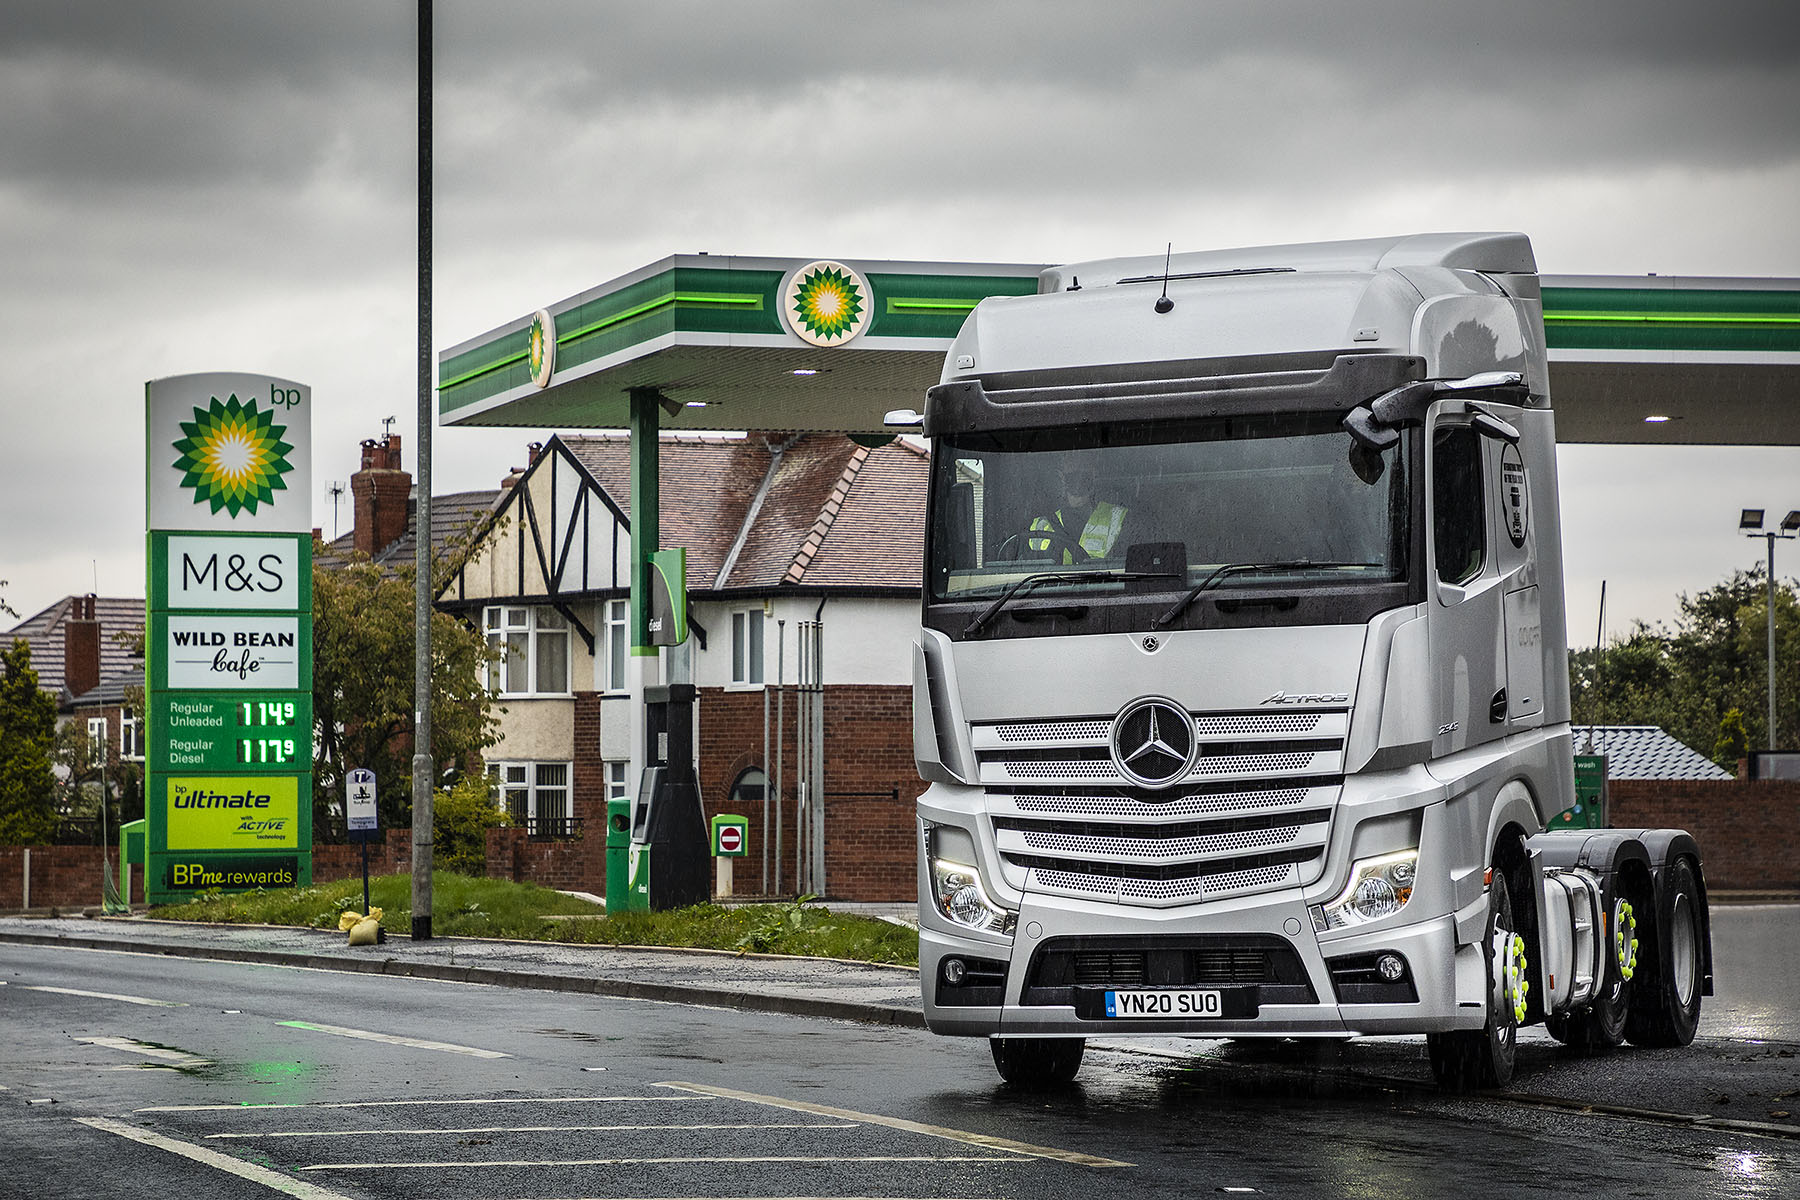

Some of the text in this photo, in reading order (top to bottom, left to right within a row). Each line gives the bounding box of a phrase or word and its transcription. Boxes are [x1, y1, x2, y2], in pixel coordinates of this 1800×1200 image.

[270, 383, 301, 410] bp
[183, 553, 283, 592] M&S
[172, 631, 294, 647] WILD BEAN
[170, 702, 214, 715] Regular
[170, 716, 223, 727] Unleaded
[170, 739, 214, 752] Regular
[169, 753, 204, 764] Diesel
[175, 784, 187, 795] bp
[174, 790, 271, 809] ultimate
[237, 821, 286, 831] ACTIVE
[227, 868, 293, 884] rewards
[1119, 994, 1218, 1013] YN20 SUO
